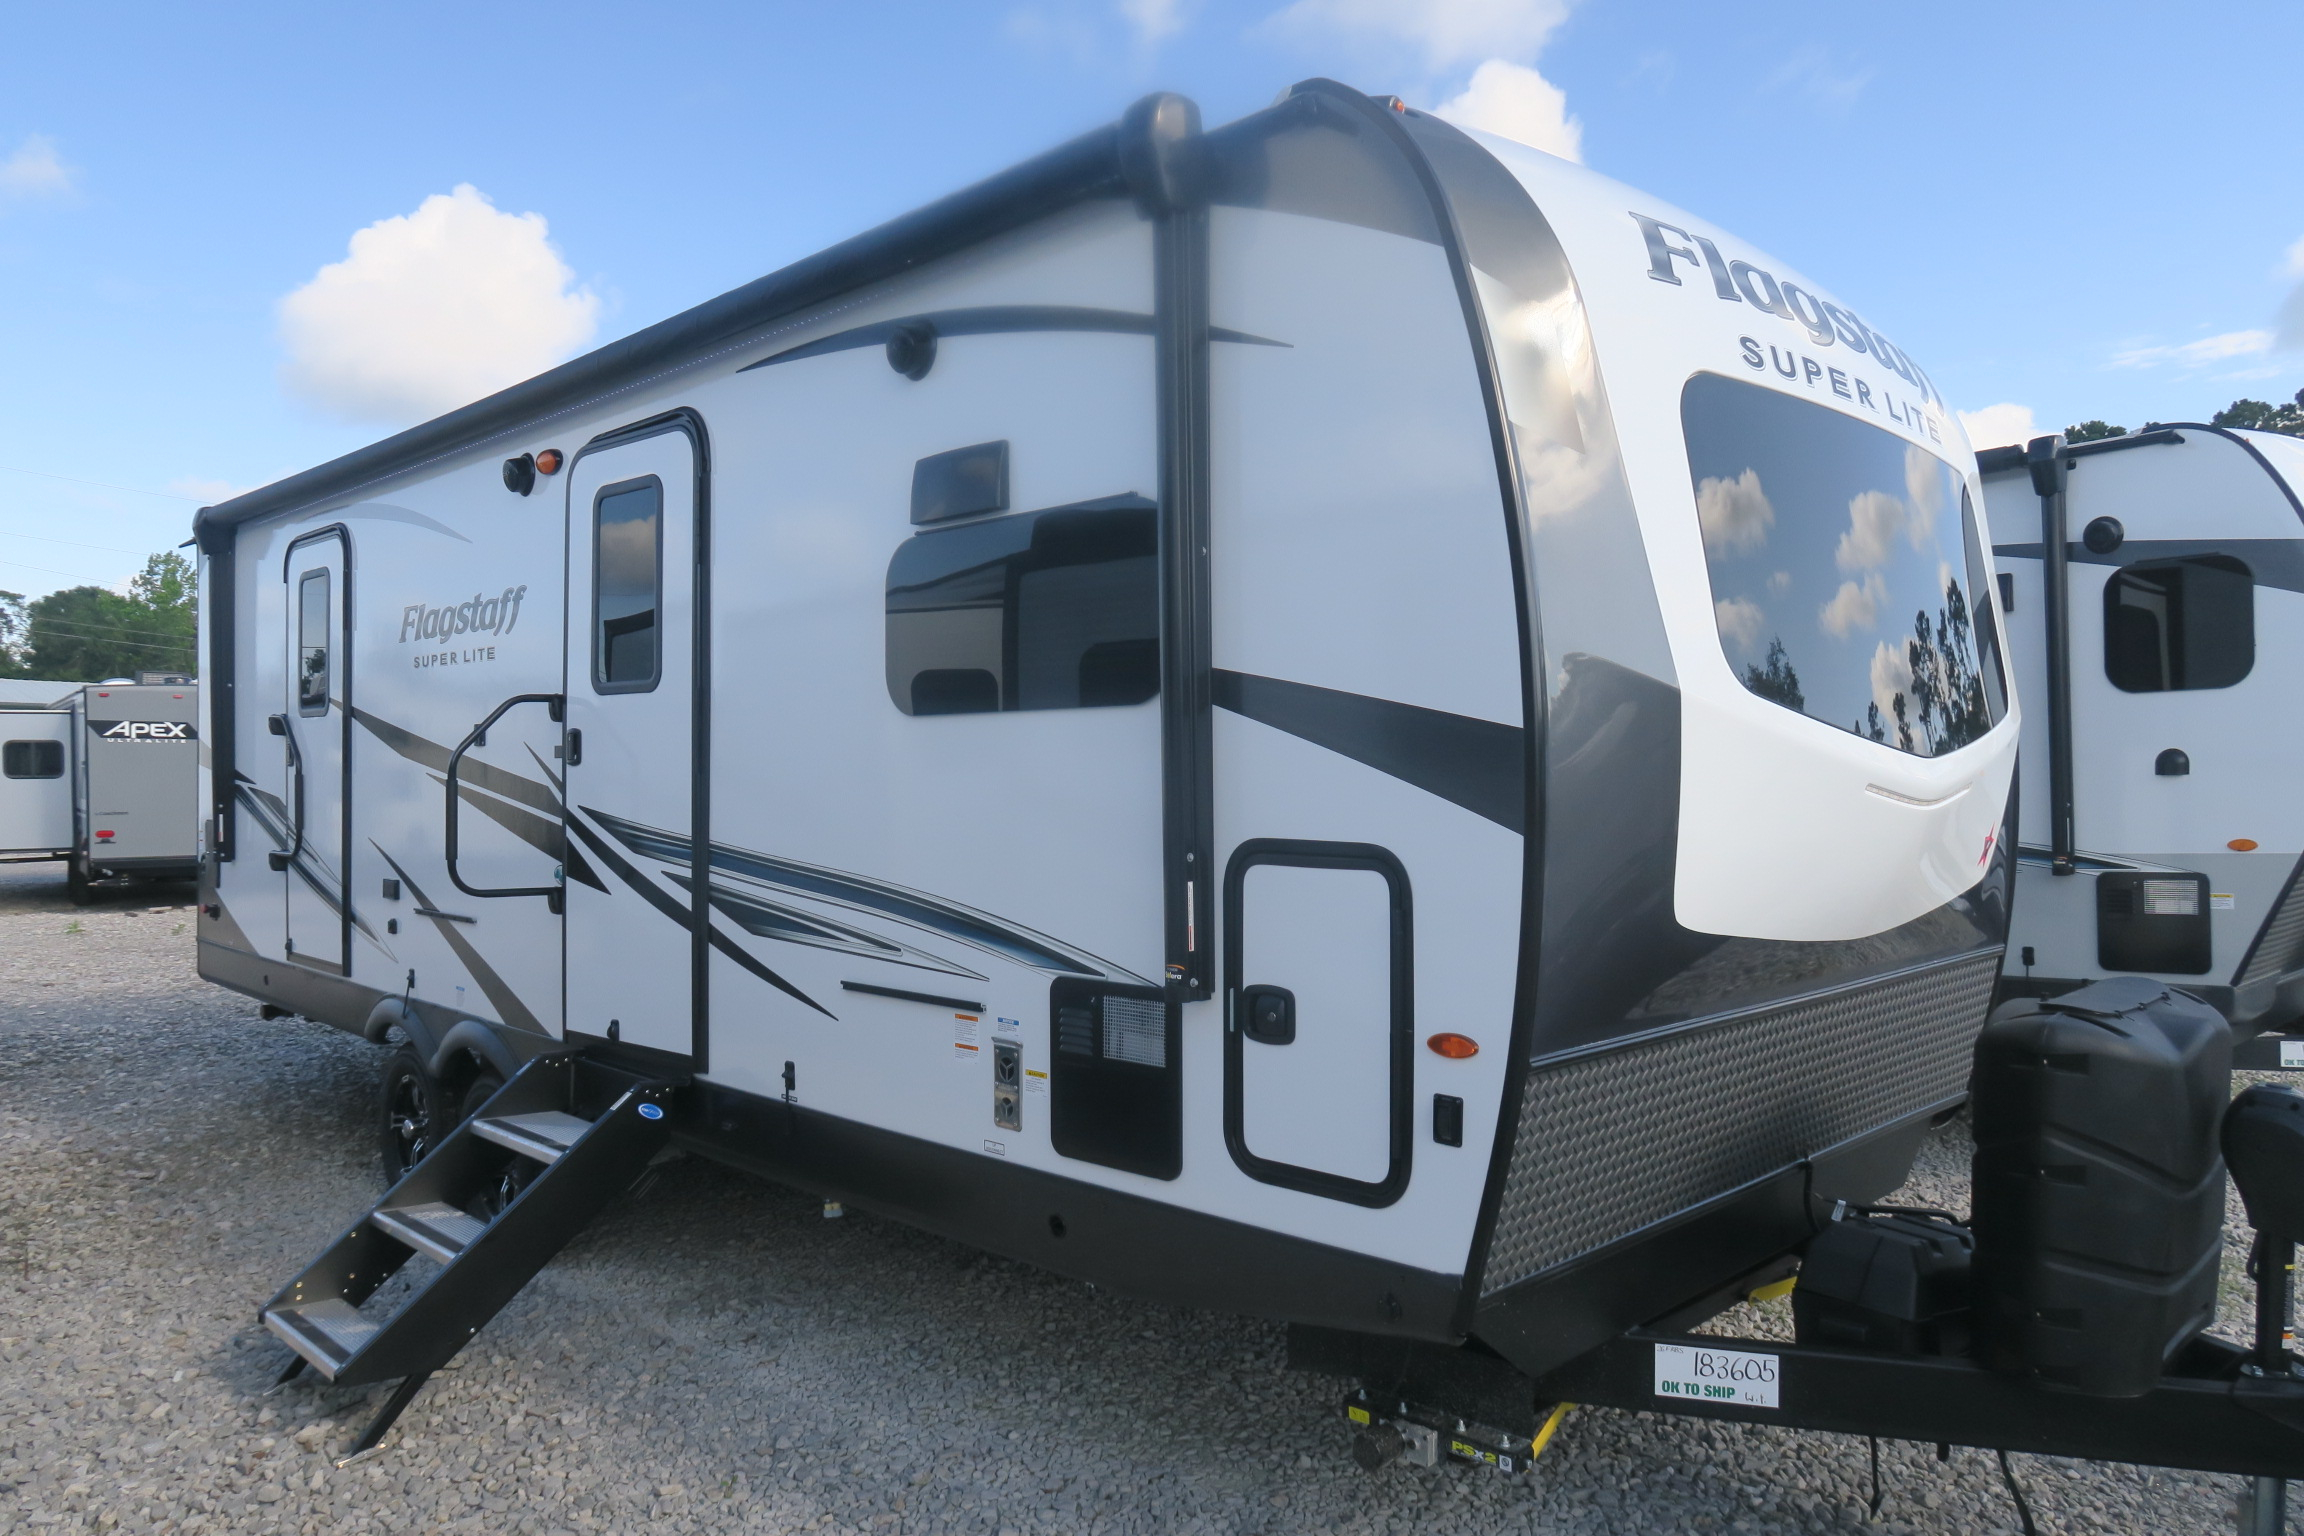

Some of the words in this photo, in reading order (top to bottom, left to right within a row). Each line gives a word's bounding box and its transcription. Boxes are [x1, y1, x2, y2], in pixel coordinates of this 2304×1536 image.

[1628, 211, 1945, 417] Flagstaff
[1739, 335, 1877, 412] SUPER
[1886, 392, 1942, 444] LITE
[398, 584, 528, 645] Flagstaff
[413, 652, 458, 669] SUPER
[463, 646, 496, 662] LITE
[102, 720, 187, 738] APEX
[1694, 1351, 1776, 1383] 183605
[1661, 1380, 1680, 1393] OK
[1684, 1382, 1700, 1396] TO
[1704, 1384, 1736, 1399] SHIP
